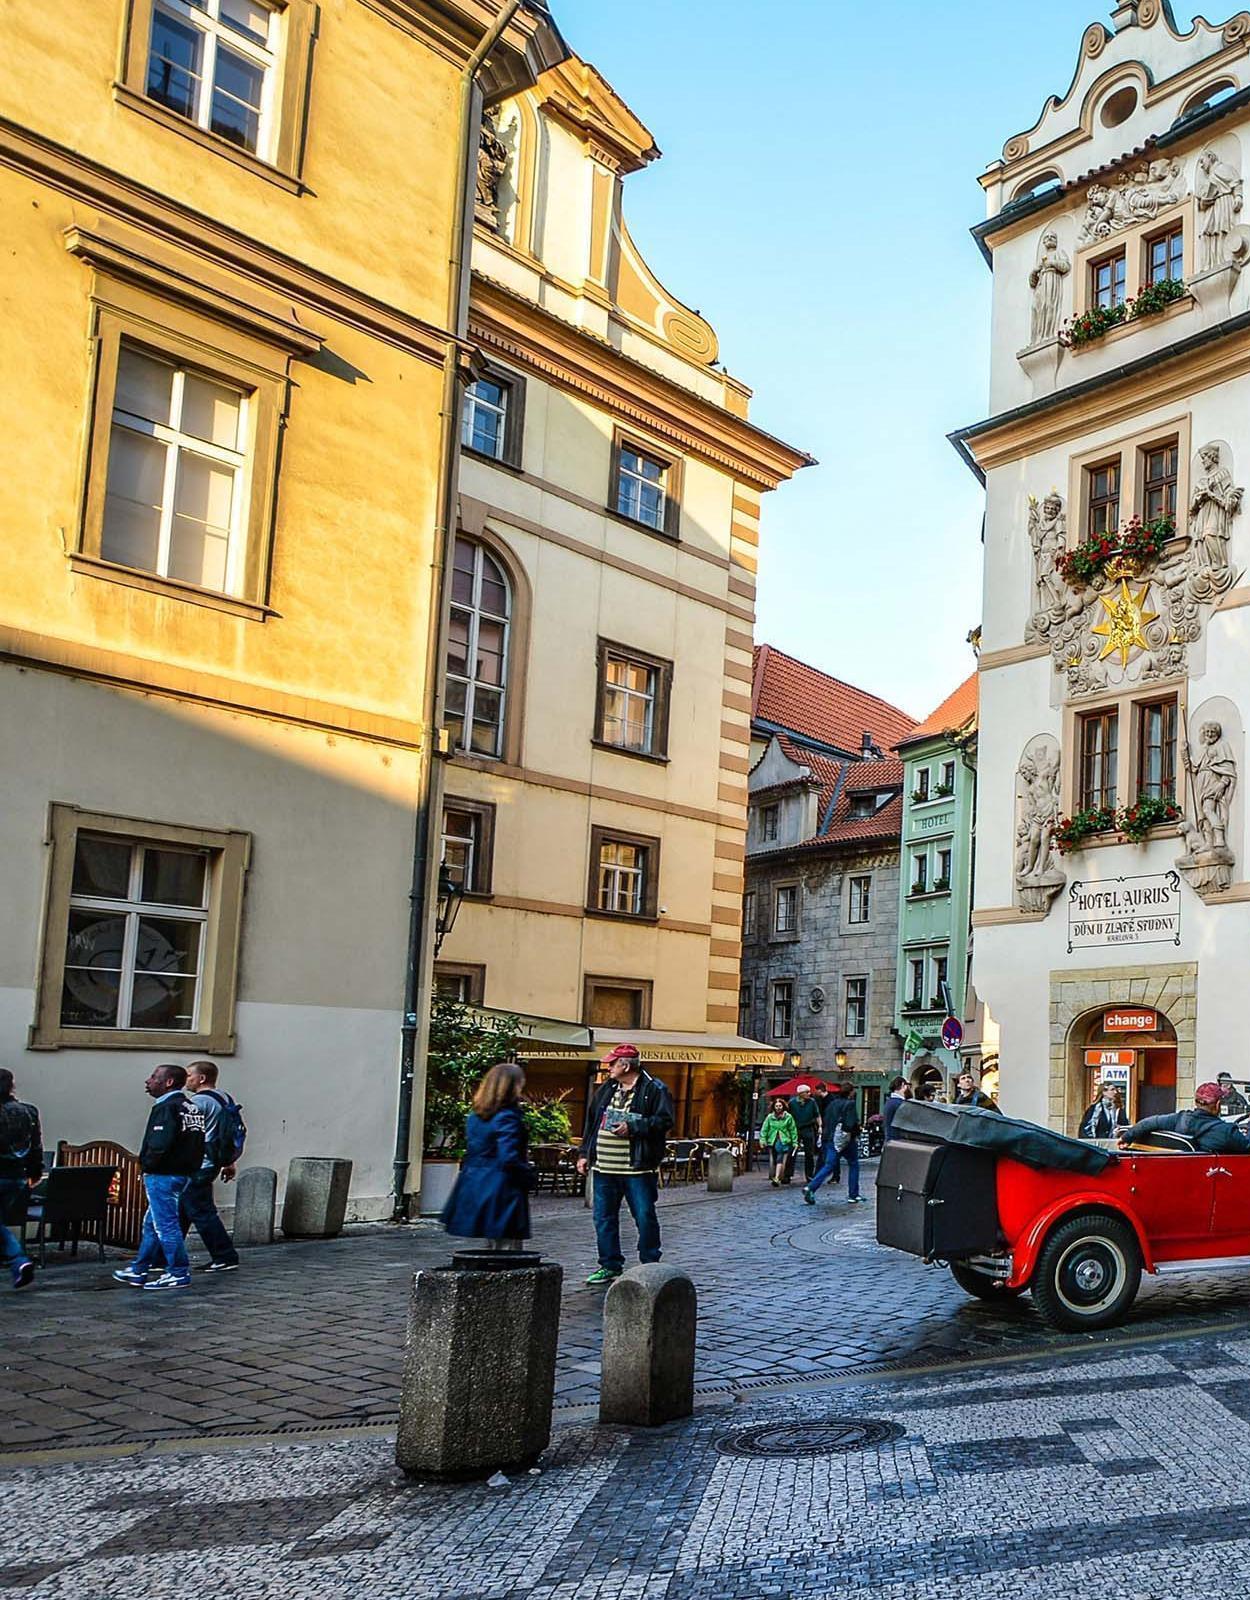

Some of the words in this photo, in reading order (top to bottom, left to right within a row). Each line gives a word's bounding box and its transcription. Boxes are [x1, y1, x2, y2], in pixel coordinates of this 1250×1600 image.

[921, 814, 949, 829] HOTEL
[1079, 891, 1121, 910] HOTEL
[1123, 887, 1170, 906] AURUS
[1137, 918, 1175, 932] STUDNY
[1107, 1014, 1153, 1028] change
[640, 1050, 704, 1061] RESTAURANT
[722, 1053, 774, 1063] CLEMENTIN
[1100, 1052, 1119, 1063] ATM
[1106, 1070, 1128, 1079] ATM
